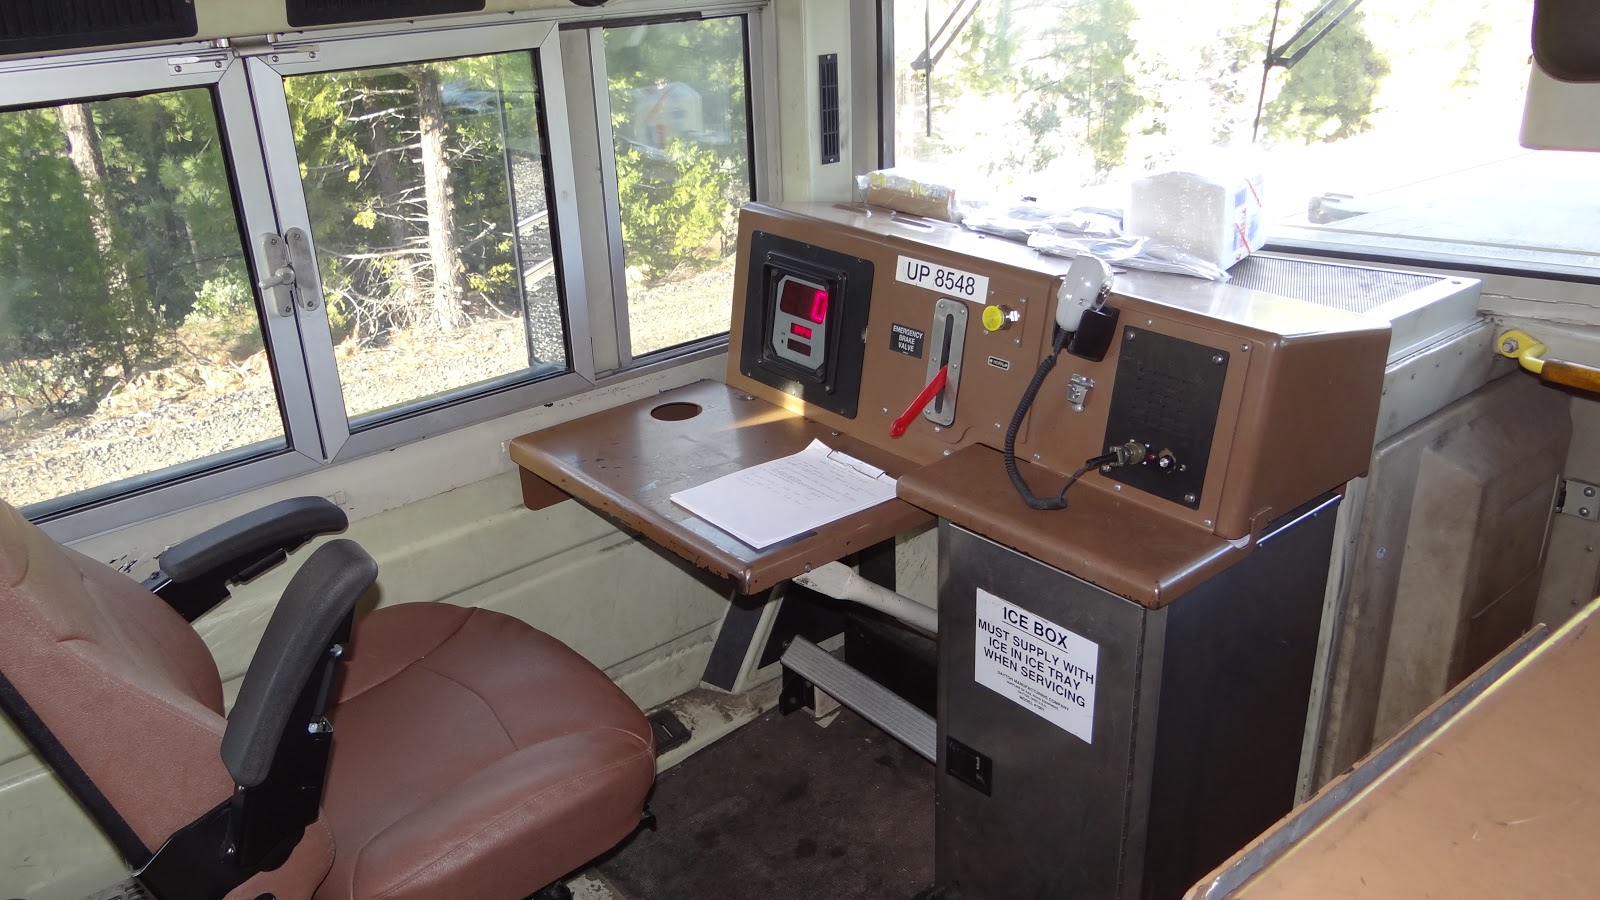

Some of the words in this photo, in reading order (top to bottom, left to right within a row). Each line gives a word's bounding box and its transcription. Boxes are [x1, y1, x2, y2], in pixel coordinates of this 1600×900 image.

[907, 261, 931, 283] UP
[934, 268, 976, 296] 8548
[892, 324, 924, 340] EMERGENCY
[898, 334, 916, 345] BRAKE
[898, 341, 915, 353] VALVE
[1003, 606, 1029, 631] ICE
[1033, 621, 1068, 650] BOX
[978, 618, 1010, 641] MUST
[1012, 635, 1060, 666] SUPPLY
[1062, 660, 1095, 685] WITH
[989, 636, 1008, 654] ICE
[1010, 647, 1023, 662] IN
[1025, 654, 1045, 673] ICE
[1047, 665, 1081, 691] TRAY
[983, 646, 1018, 673] WHEN
[1020, 665, 1086, 708] SERVICING
